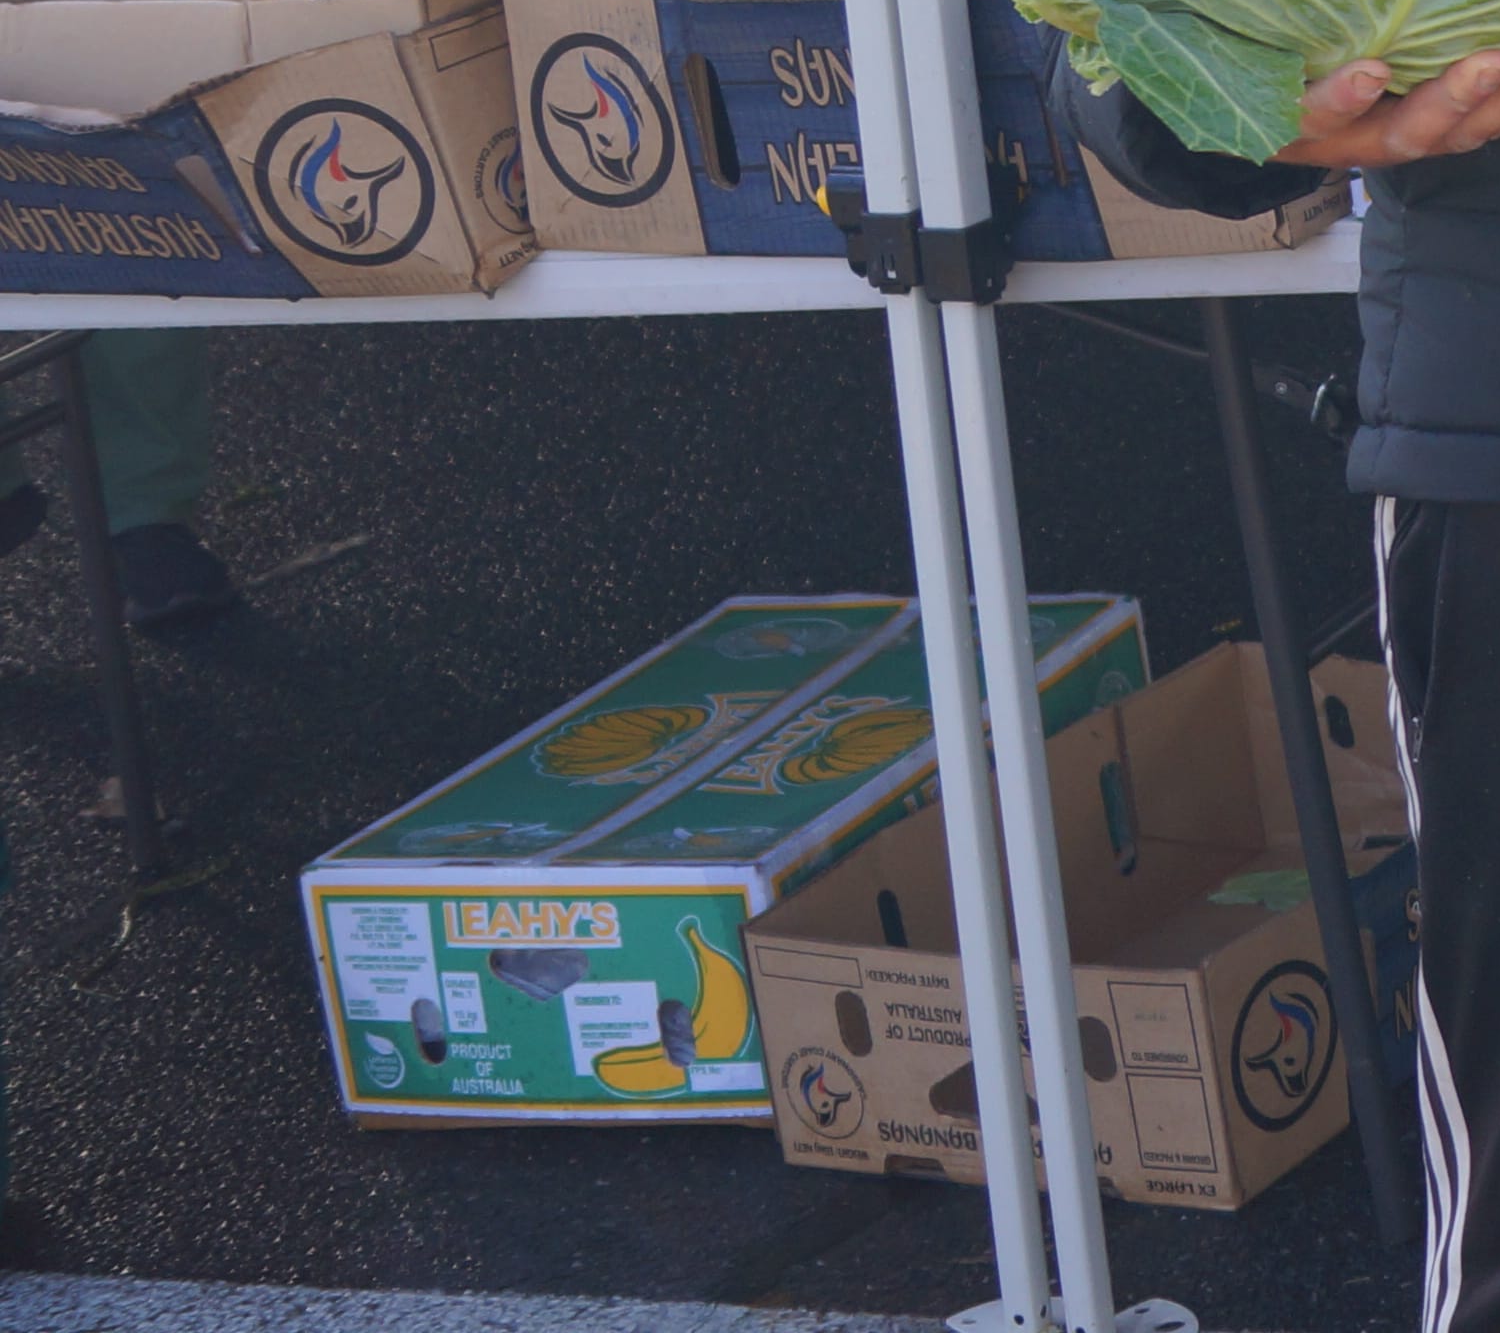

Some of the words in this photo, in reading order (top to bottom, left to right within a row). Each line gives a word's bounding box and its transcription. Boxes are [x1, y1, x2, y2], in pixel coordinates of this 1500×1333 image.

[443, 901, 622, 948] LEAHY'S
[919, 975, 950, 990] DATE
[884, 1002, 962, 1024] AUSTRALIA
[885, 1023, 904, 1039] OF
[908, 1025, 972, 1048] PRODUCT
[450, 1043, 512, 1060] PRODUCT
[475, 1061, 494, 1077] OF
[450, 1077, 525, 1094] AUSTRALIA
[877, 1120, 978, 1152] BANANAS
[1145, 1179, 1194, 1195] LARGE
[1196, 1184, 1217, 1197] EX
